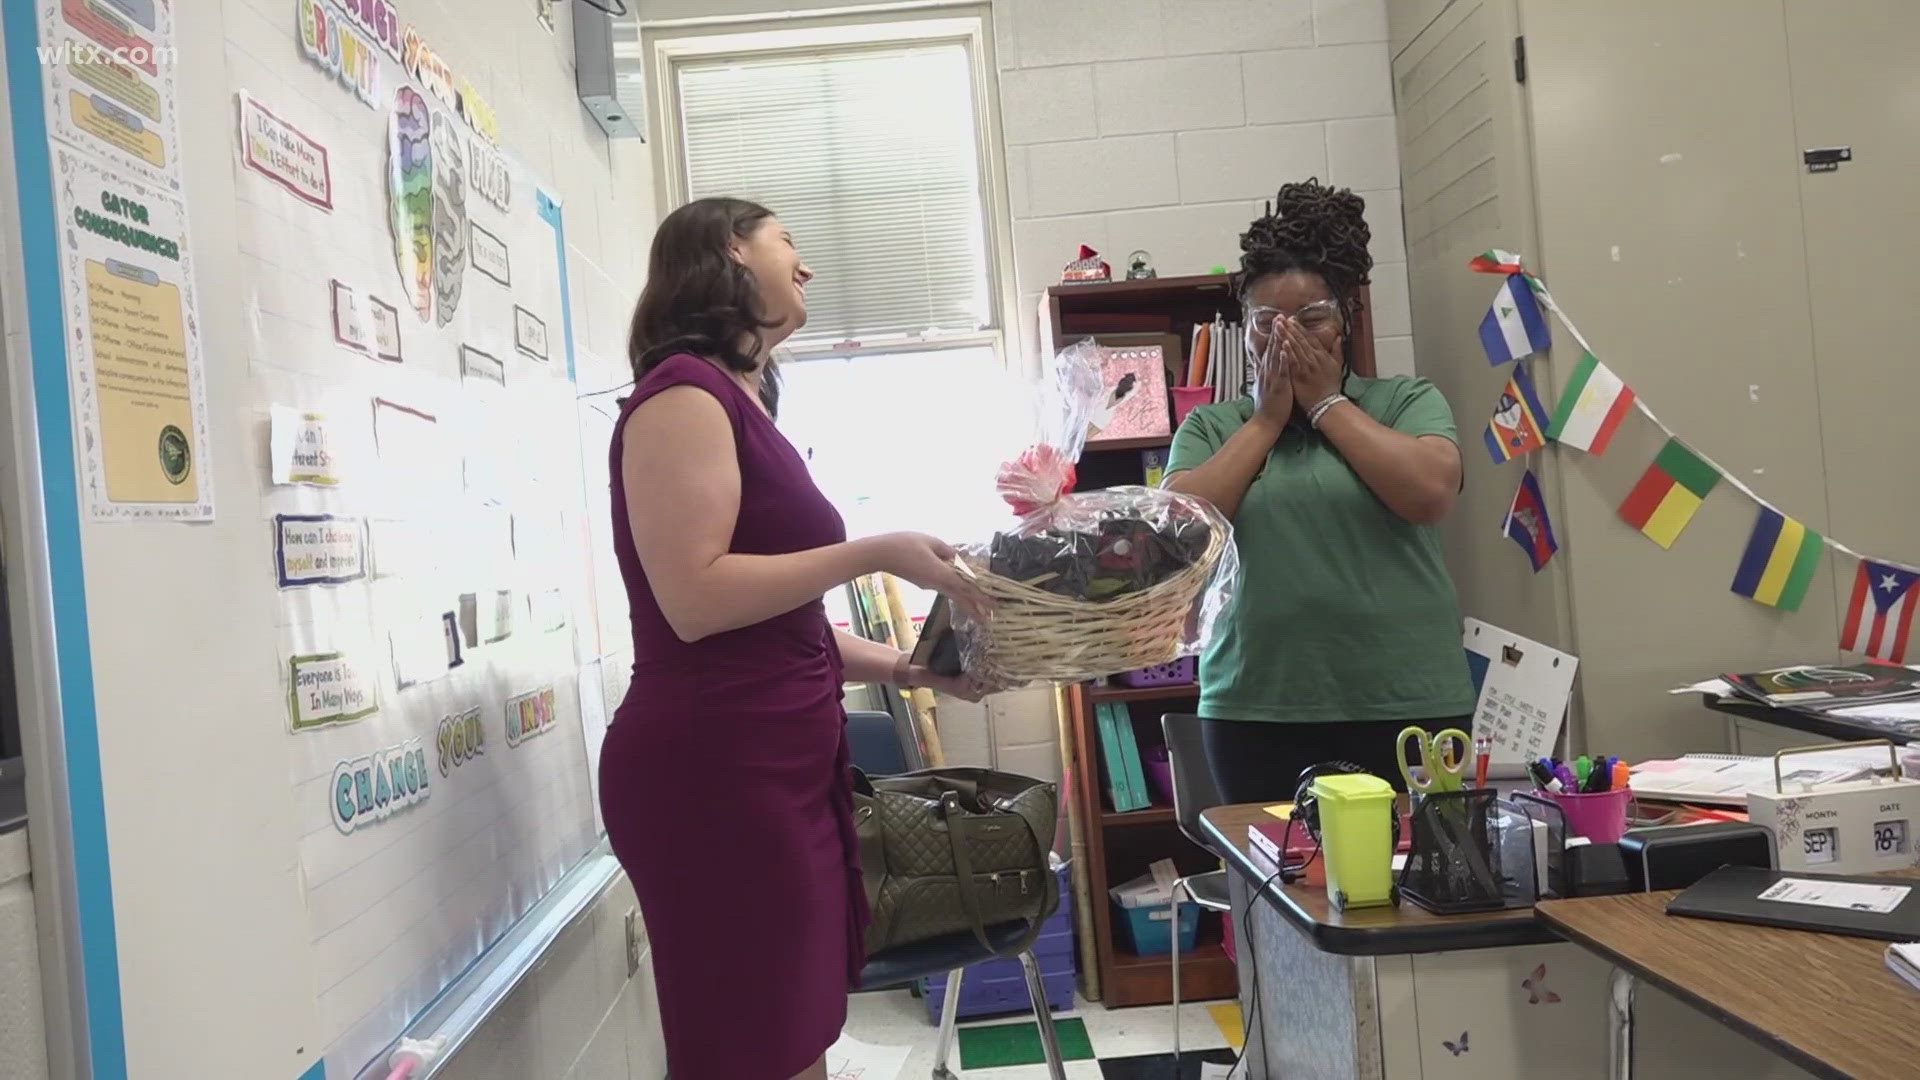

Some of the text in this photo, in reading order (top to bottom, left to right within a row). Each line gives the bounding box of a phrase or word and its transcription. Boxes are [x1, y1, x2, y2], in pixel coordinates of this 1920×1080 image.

[101, 190, 149, 226] GATOR
[303, 531, 318, 544] can
[314, 552, 328, 569] and
[296, 668, 333, 690] Everyone
[310, 692, 321, 711] In
[336, 748, 429, 823] CHANGE
[1805, 810, 1838, 819] MONTH
[1880, 803, 1900, 812] DATE
[1804, 831, 1828, 854] SEP
